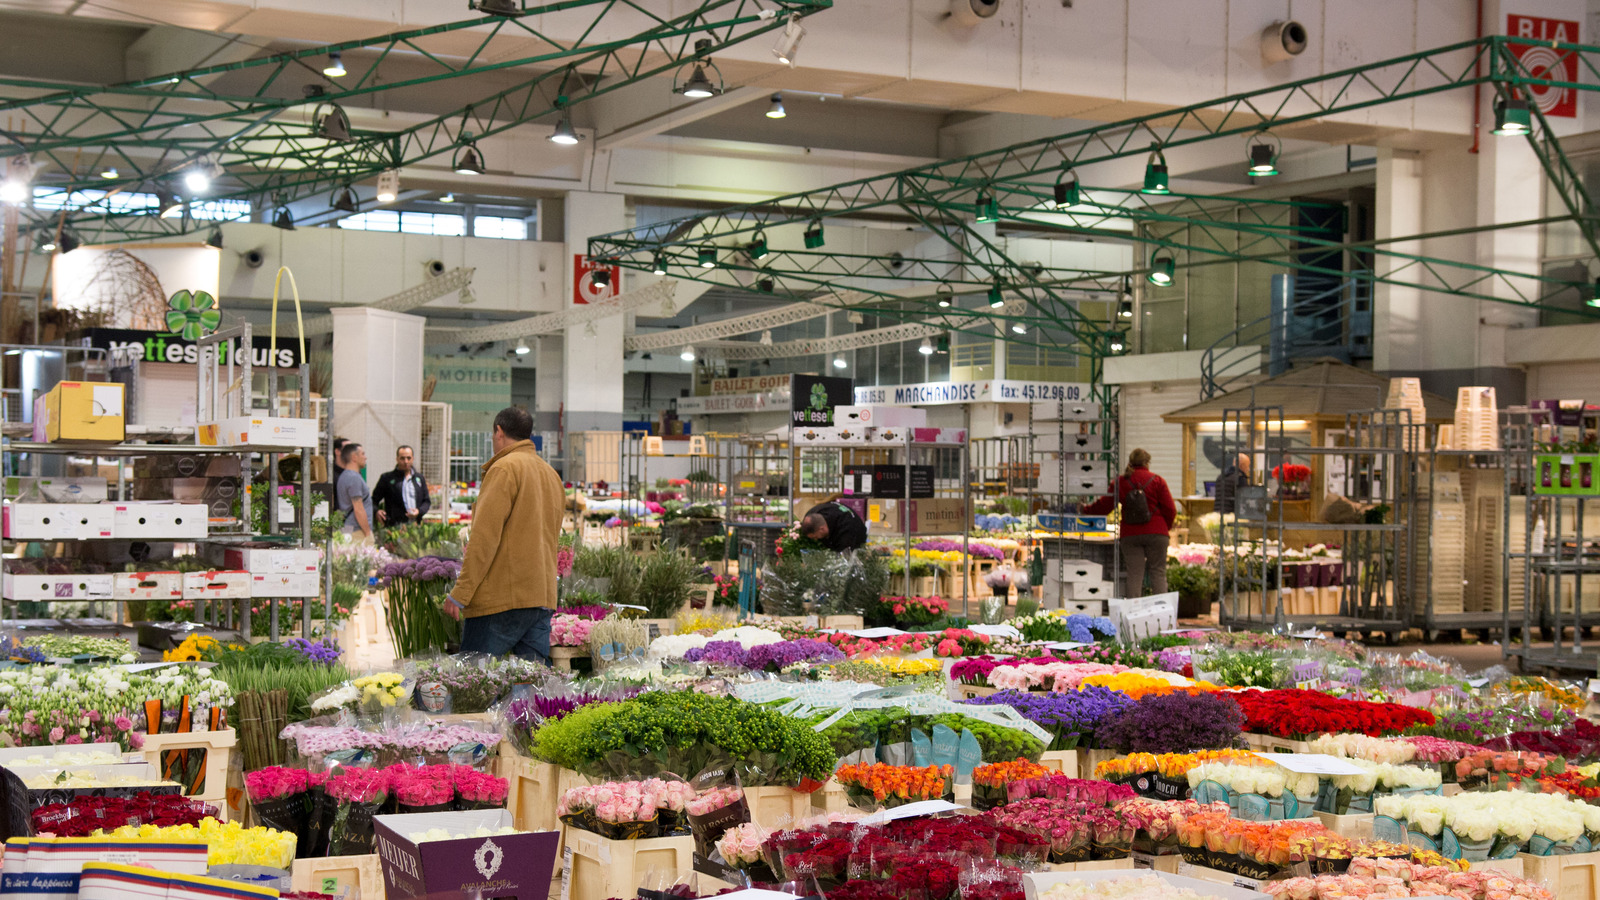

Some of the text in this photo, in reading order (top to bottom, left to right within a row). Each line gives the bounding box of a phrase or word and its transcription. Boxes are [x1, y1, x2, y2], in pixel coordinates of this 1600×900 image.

[109, 338, 295, 368] vettesefeurs
[439, 369, 509, 382] MOTTIER
[894, 383, 976, 404] MARCHANDISE
[1001, 384, 1080, 400] fax: 45.12.96.09
[793, 409, 835, 423] vettesefl
[925, 507, 960, 521] matina
[378, 834, 420, 881] MEIJER
[31, 877, 74, 889] happiness
[324, 879, 336, 891] 2
